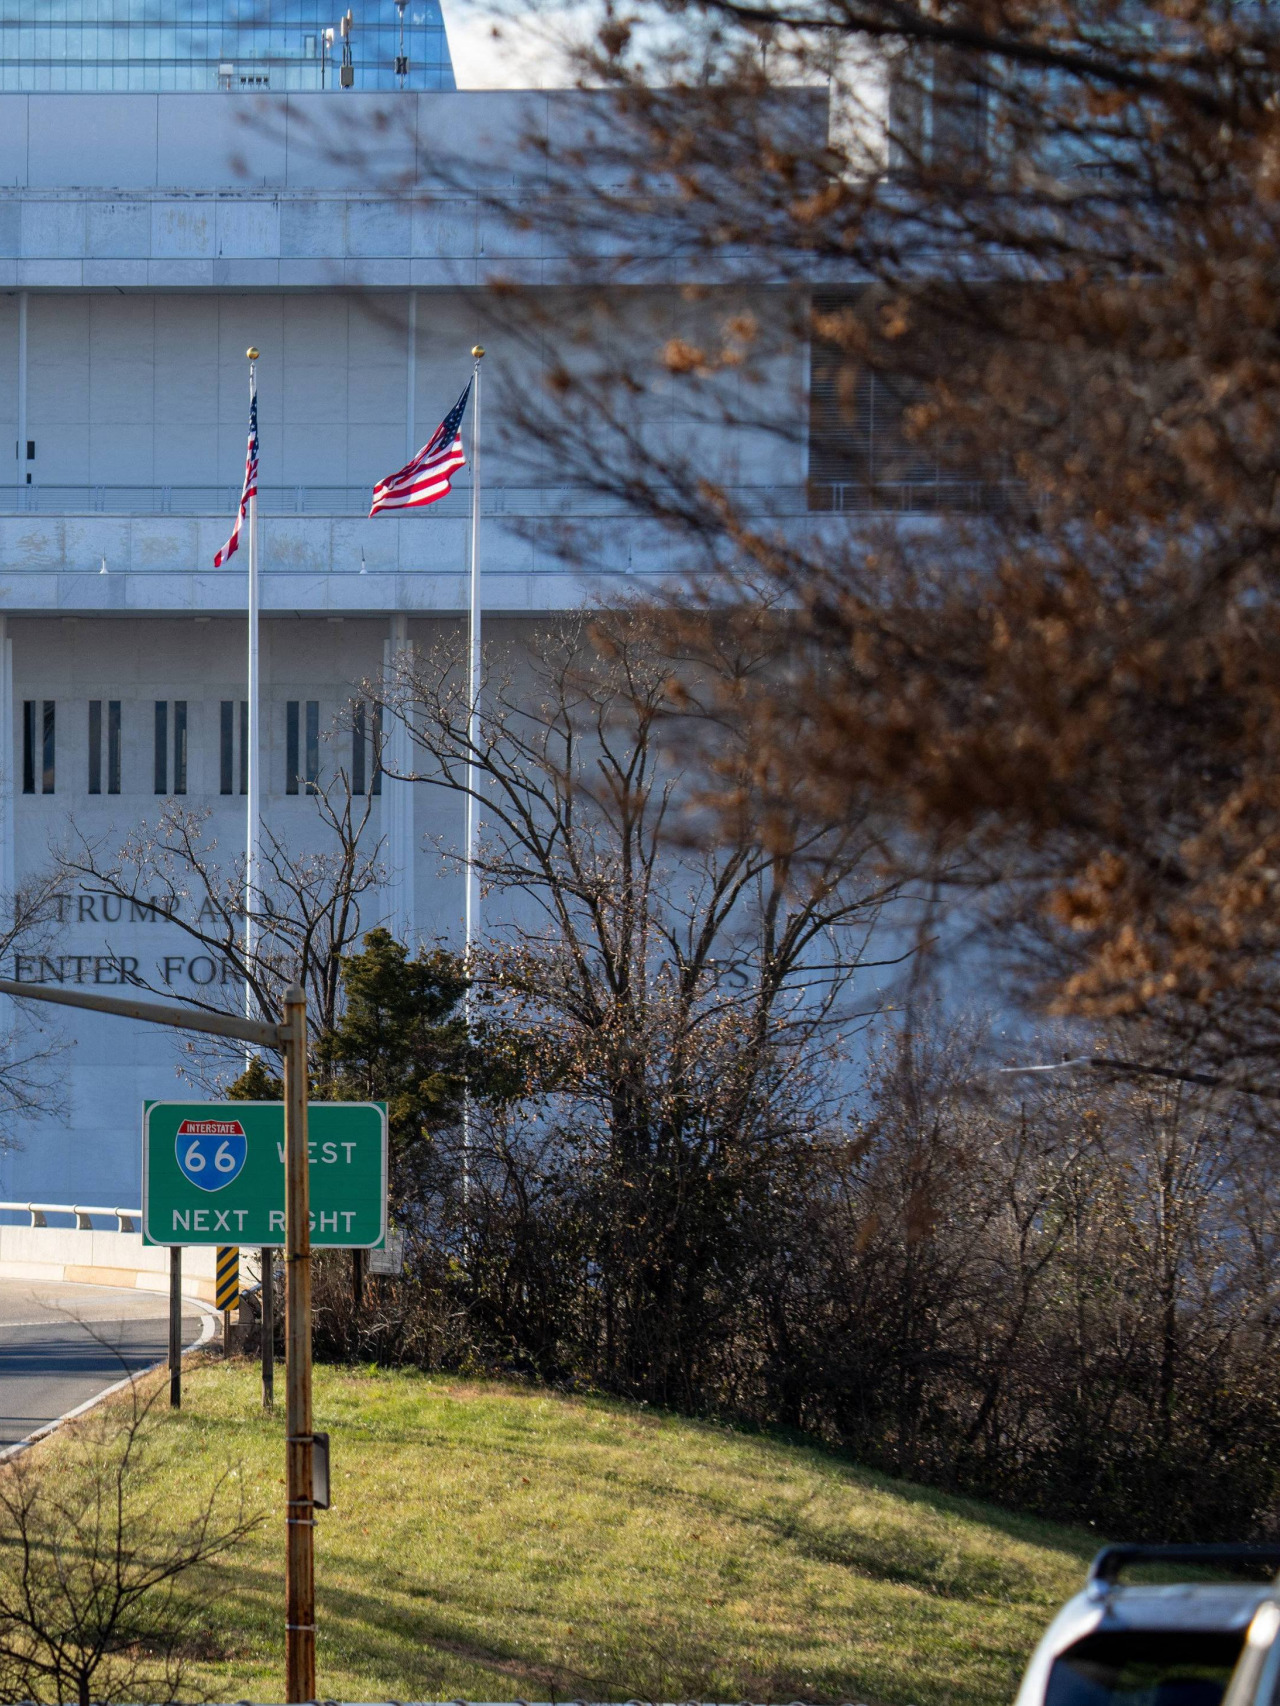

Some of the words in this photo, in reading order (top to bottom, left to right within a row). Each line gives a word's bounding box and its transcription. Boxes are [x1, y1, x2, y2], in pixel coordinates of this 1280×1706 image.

[56, 895, 180, 923] TRUMP
[14, 954, 146, 984] ENTER
[186, 1123, 236, 1134] INTERSTATE
[184, 1140, 236, 1173] 66
[172, 1209, 249, 1232] NEXT
[269, 1210, 357, 1233] RHT
